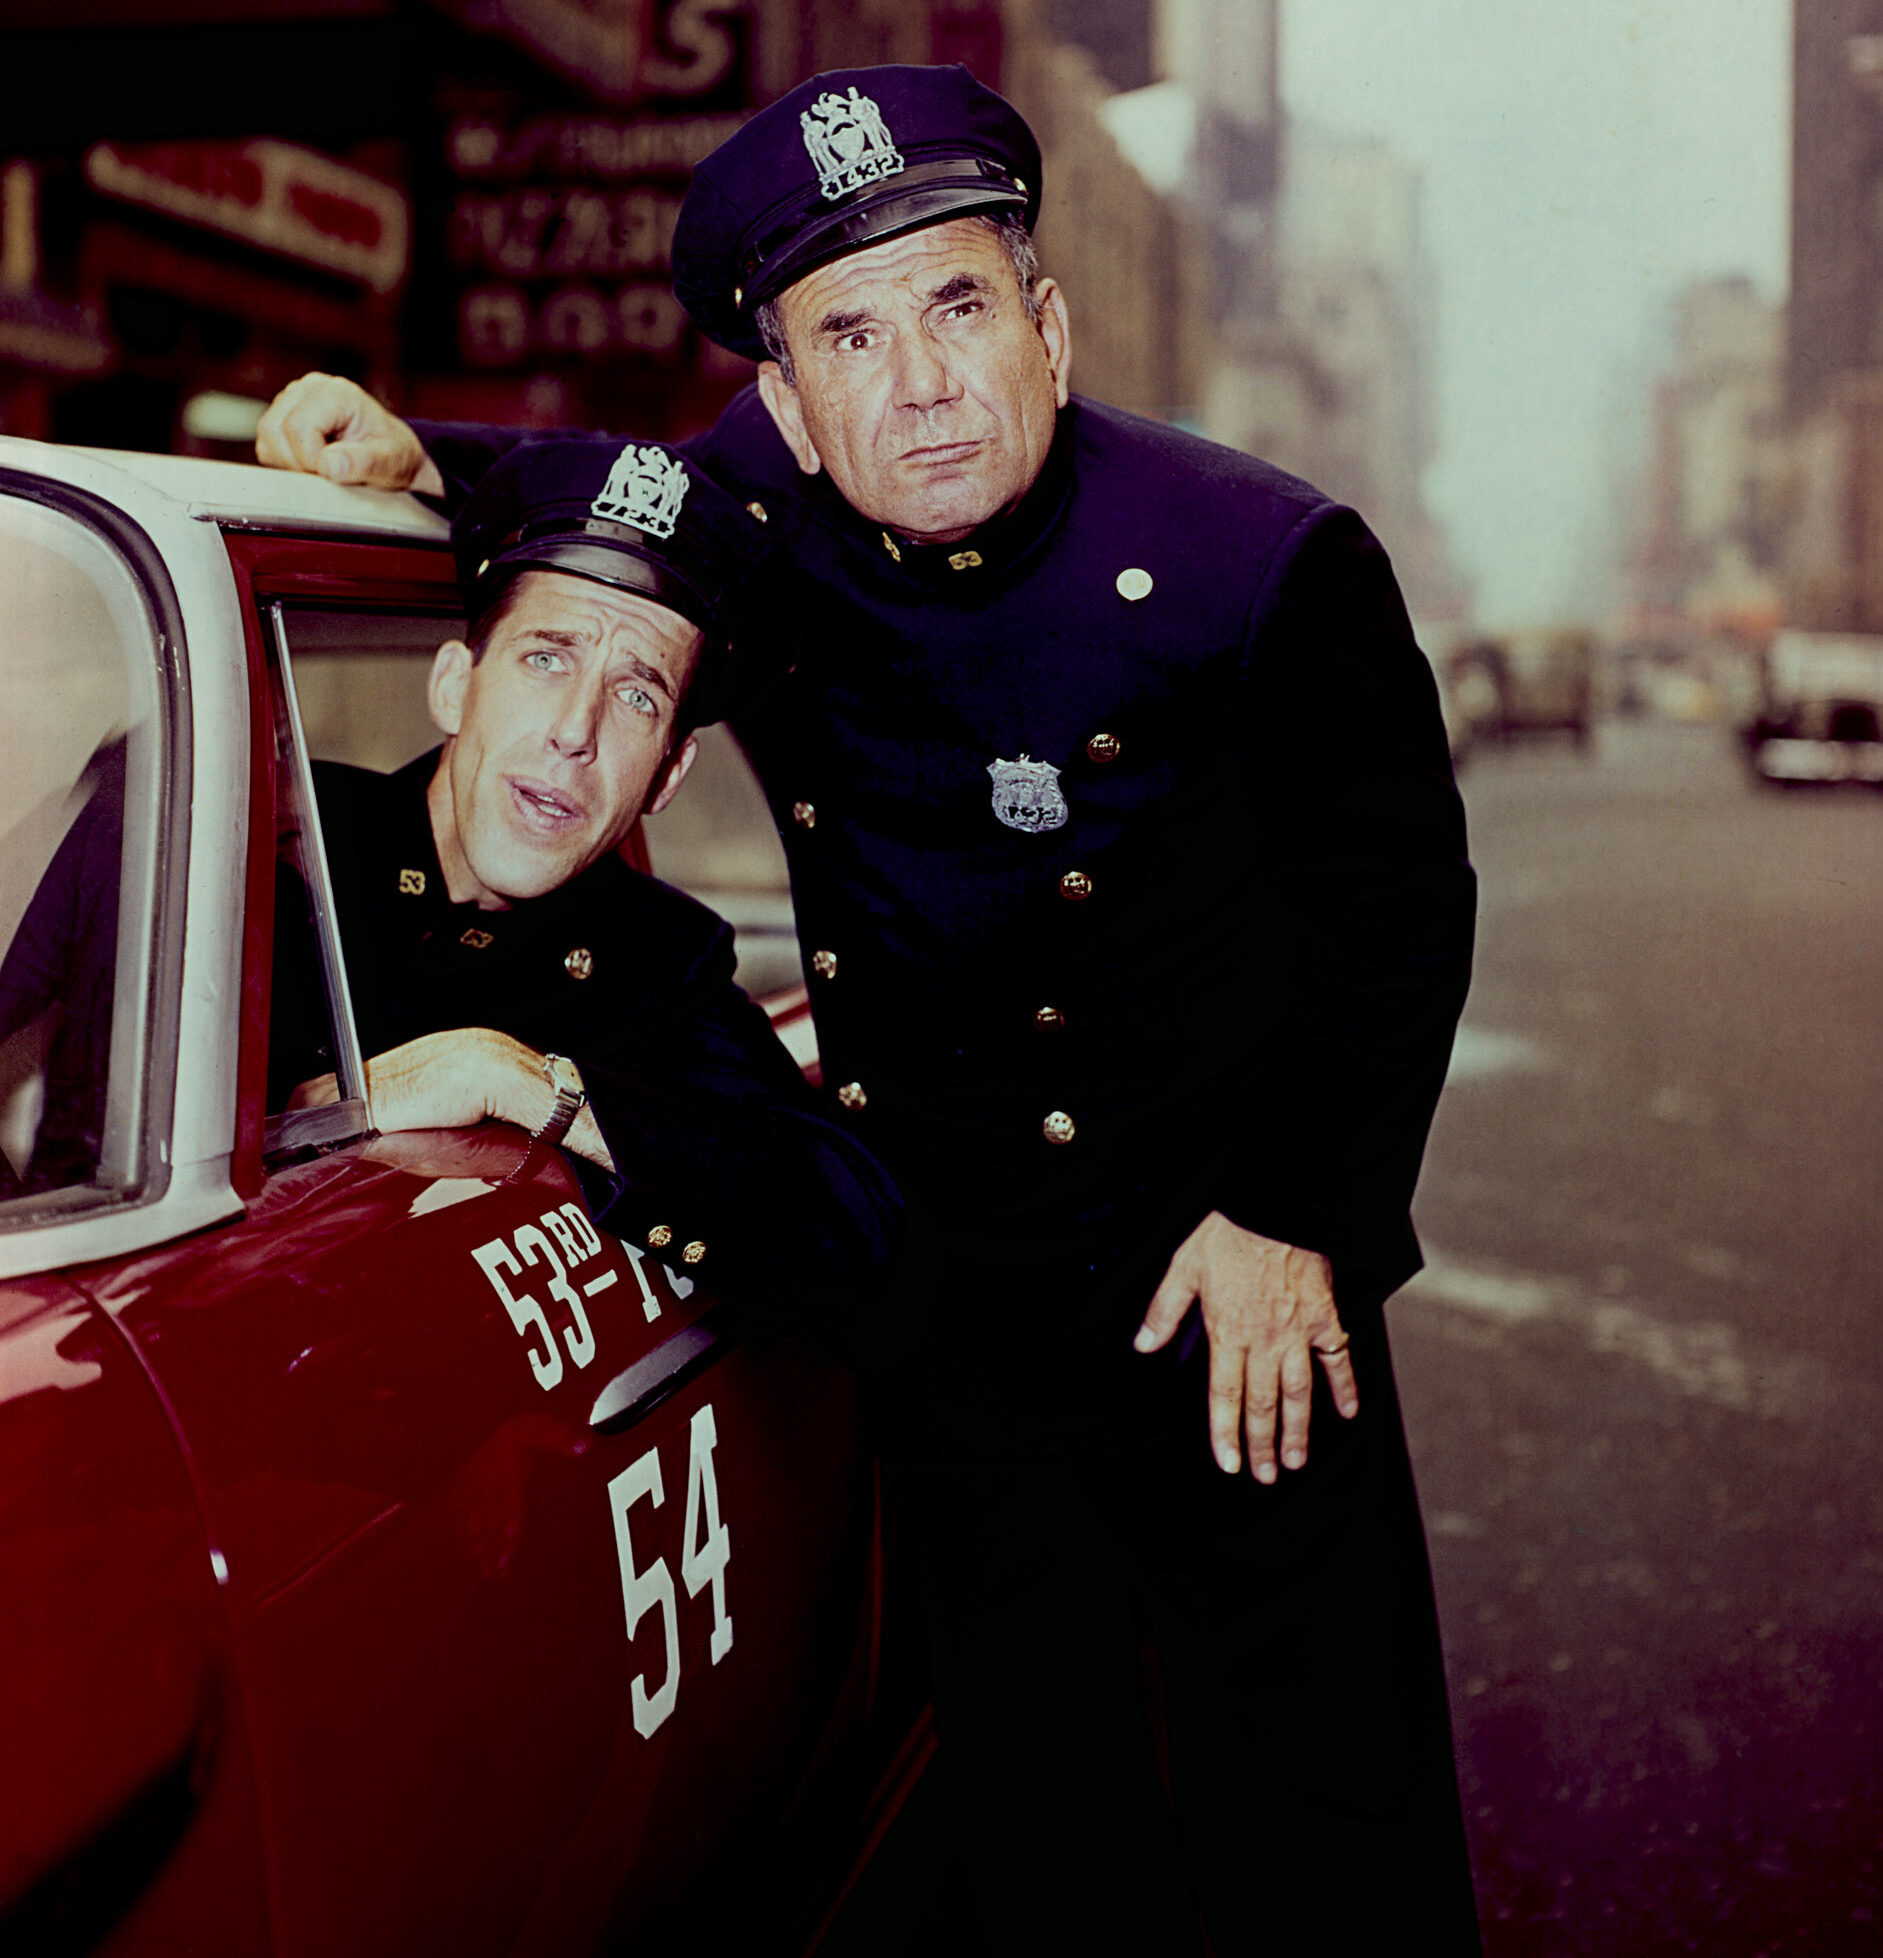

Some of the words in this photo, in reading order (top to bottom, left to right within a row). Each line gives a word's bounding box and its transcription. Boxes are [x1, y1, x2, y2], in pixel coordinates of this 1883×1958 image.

[829, 152, 904, 197] 1432
[398, 868, 427, 896] 53
[607, 1403, 734, 1740] 54
